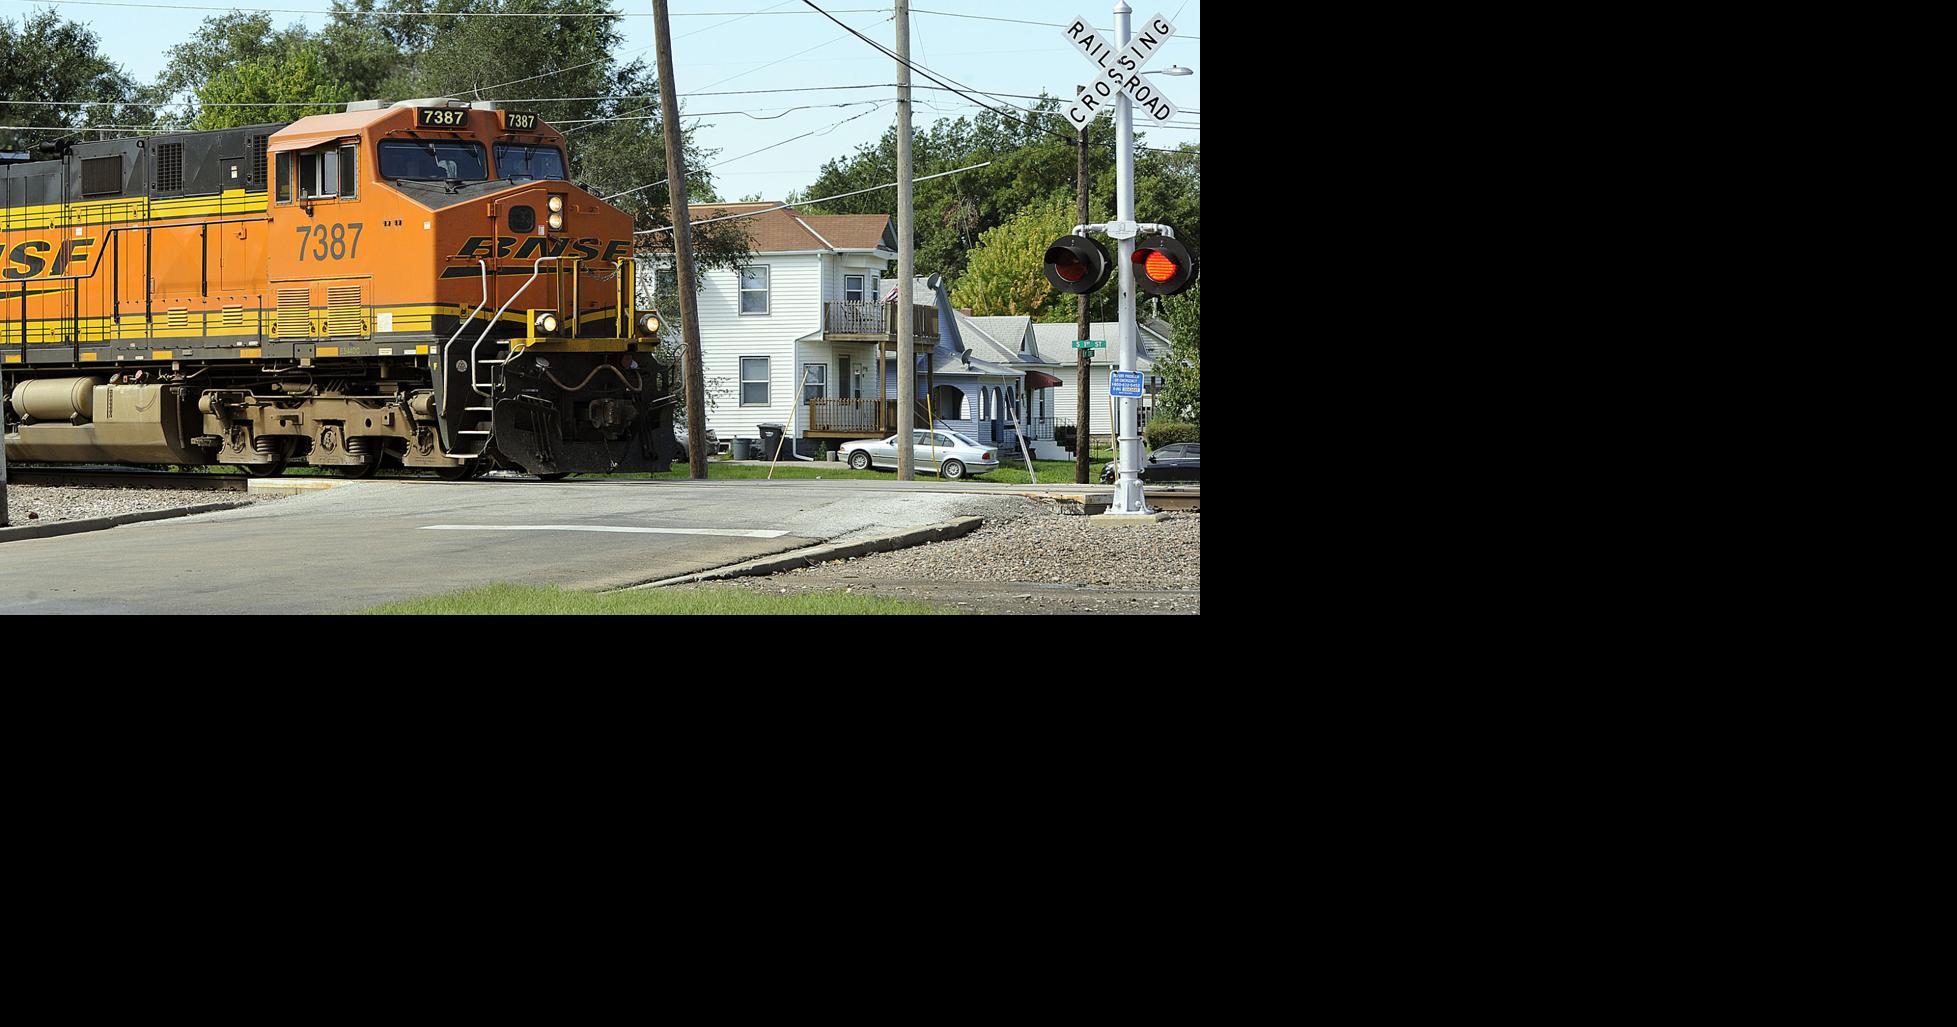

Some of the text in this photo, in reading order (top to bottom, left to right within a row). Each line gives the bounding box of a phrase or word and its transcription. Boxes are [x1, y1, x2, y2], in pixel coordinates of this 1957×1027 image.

[1070, 19, 1169, 123] CROSSING
[424, 110, 464, 125] 7387
[509, 114, 535, 129] 7387
[296, 223, 364, 261] 7387
[457, 236, 632, 262] BNSF
